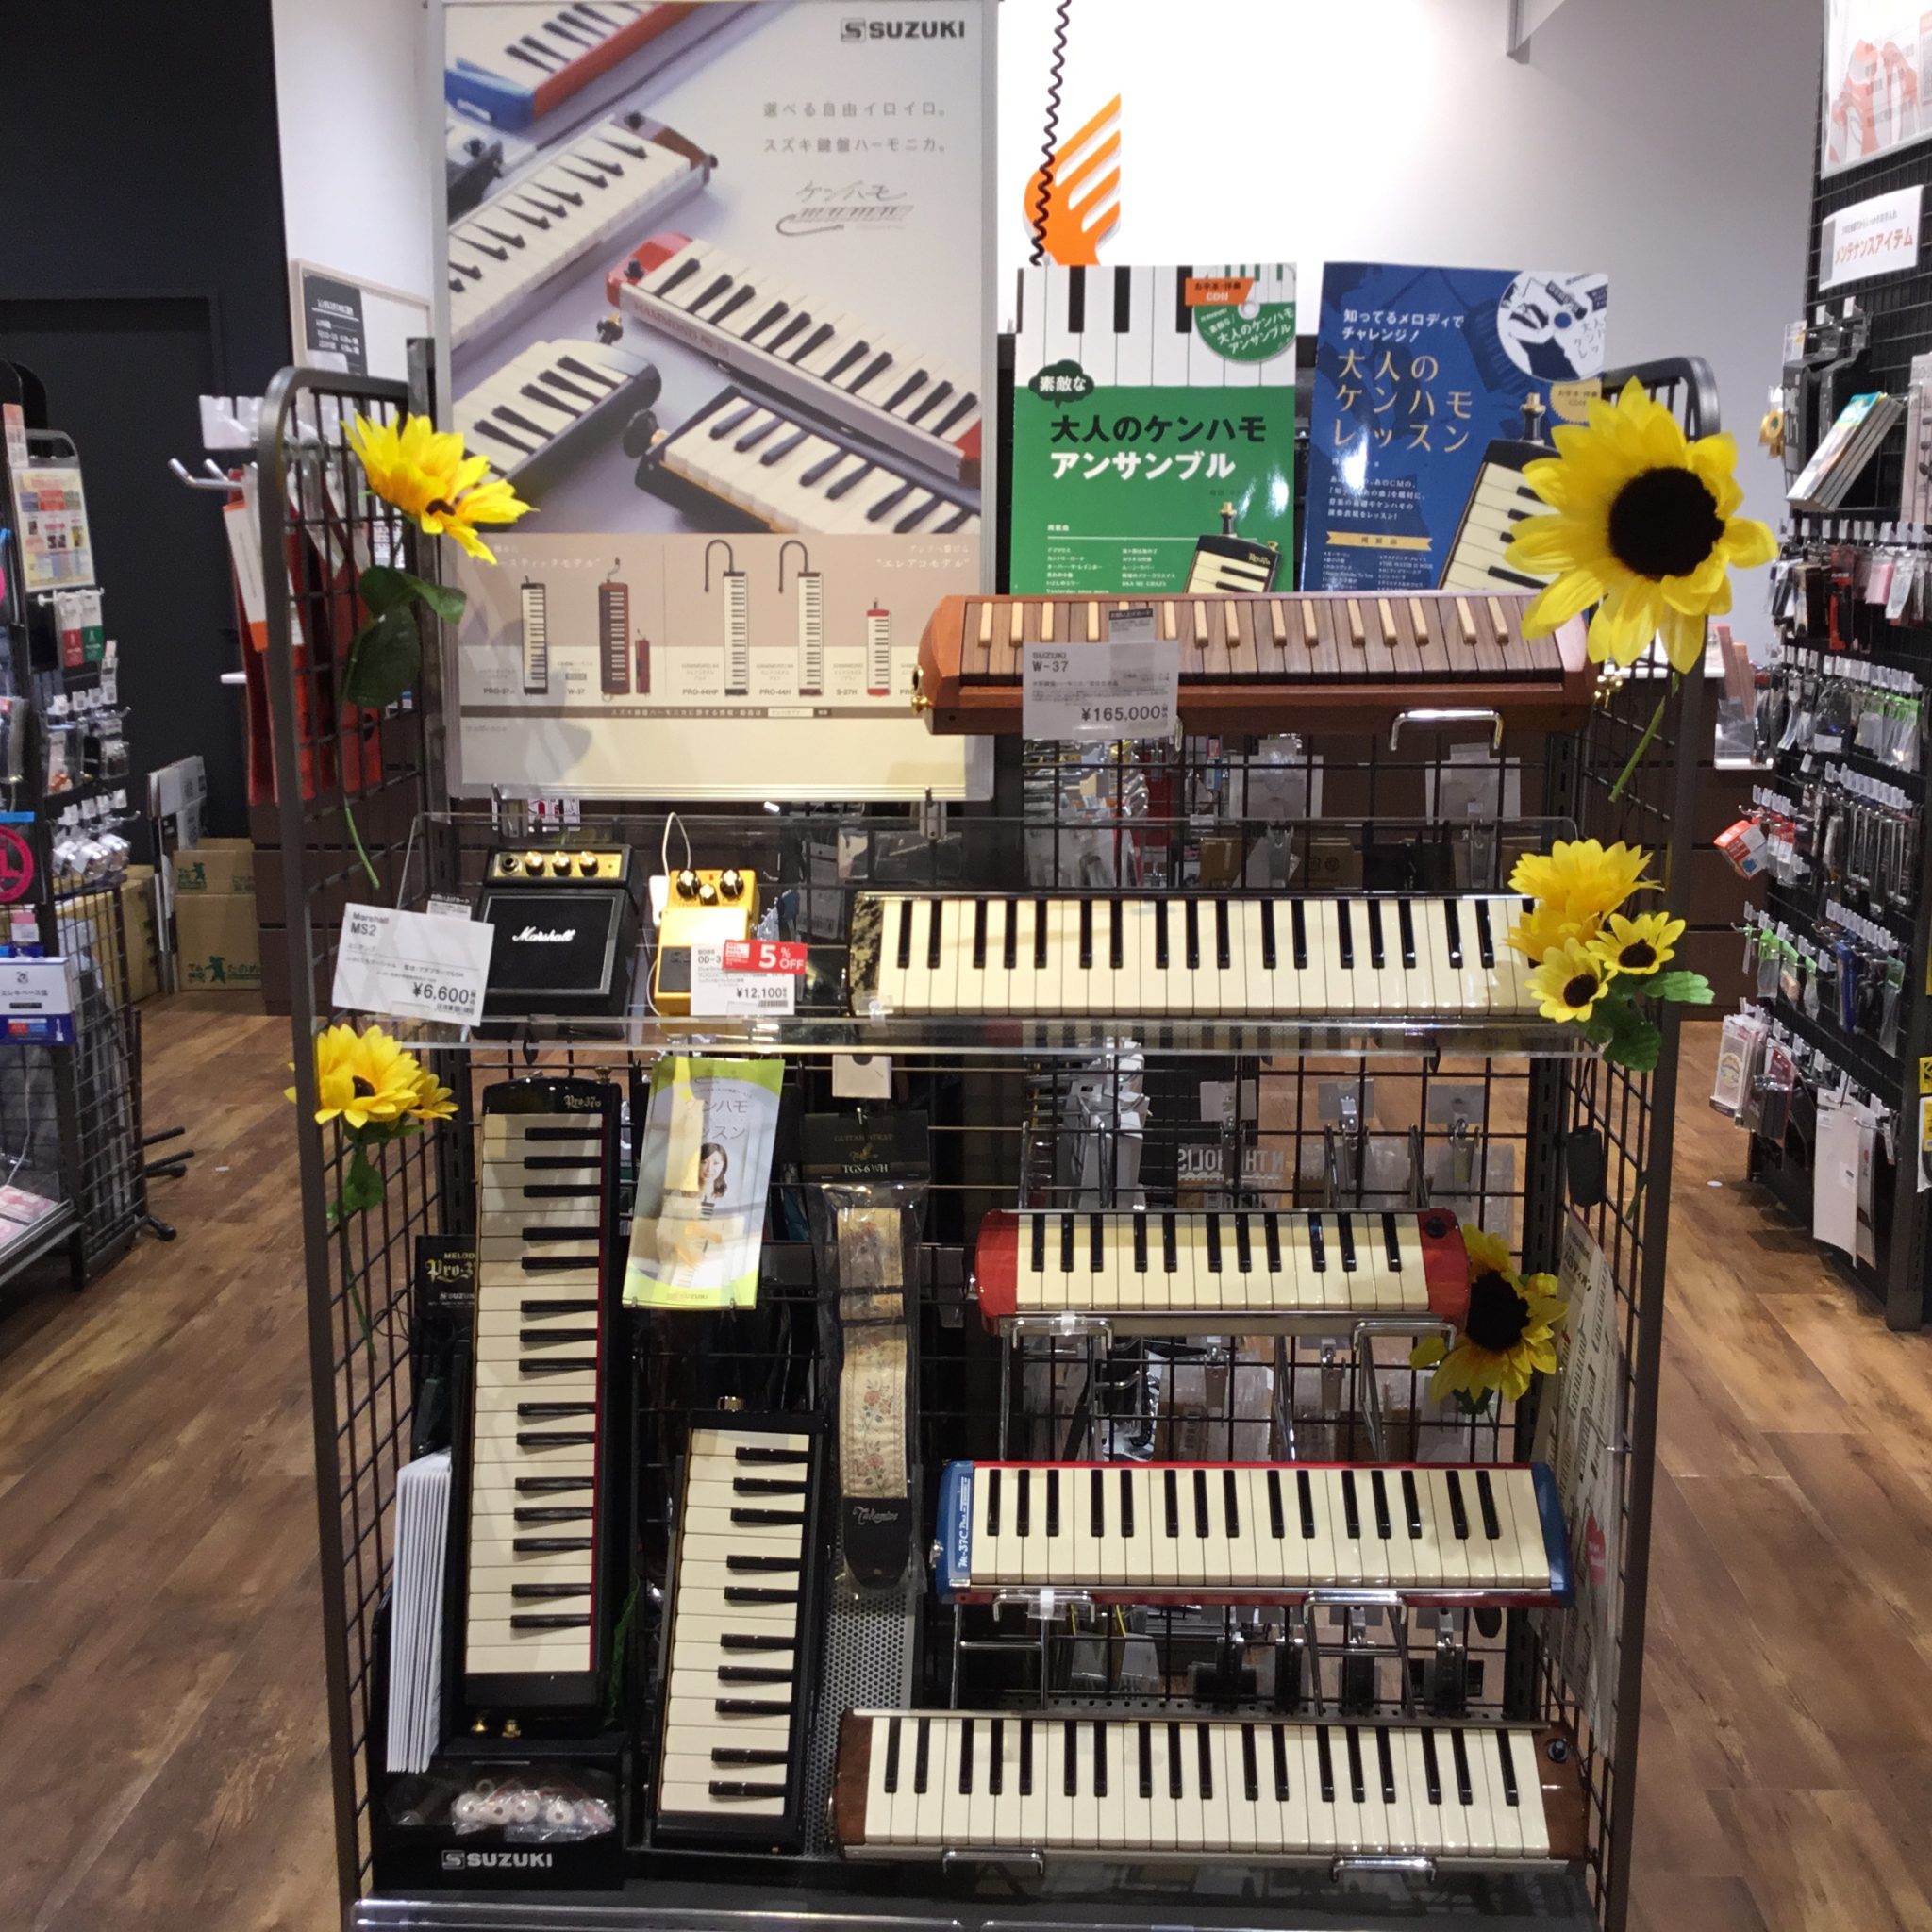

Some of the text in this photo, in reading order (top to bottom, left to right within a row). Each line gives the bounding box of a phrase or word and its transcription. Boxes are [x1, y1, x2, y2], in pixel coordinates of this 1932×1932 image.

[869, 20, 965, 39] SUZUKI
[763, 101, 945, 118] 選べる自由イロイロ。
[763, 137, 945, 153] スズキ鍵盤ハーモニカ。
[1835, 225, 1913, 265] メンテナンスアイテム
[1217, 307, 1294, 346] 大人のケンハモ
[1343, 308, 1464, 328] 知ってるメロディで
[1228, 324, 1291, 355] アンサンブル
[1342, 326, 1420, 343] チャレンジ!
[1338, 348, 1439, 382] 大人の
[1039, 375, 1087, 392] 素敵な
[1335, 384, 1473, 419] ケンハモ
[1050, 414, 1267, 443] 大人のケンハモ
[1334, 418, 1470, 453] レッスン
[1050, 450, 1237, 480] アンサンブル
[1033, 661, 1069, 673] W-37
[1081, 706, 1160, 722] ¥165,000
[352, 912, 390, 924] Marshall
[351, 922, 376, 937] MS2
[511, 925, 576, 942] Marshall
[698, 956, 722, 965] OD-3
[758, 944, 777, 969] 5
[779, 958, 805, 971] OFF
[412, 982, 470, 1005] ¥6,600
[737, 987, 782, 999] ¥12,100
[425, 1258, 474, 1283] Pro-3
[467, 1852, 553, 1867] SUZUKI
